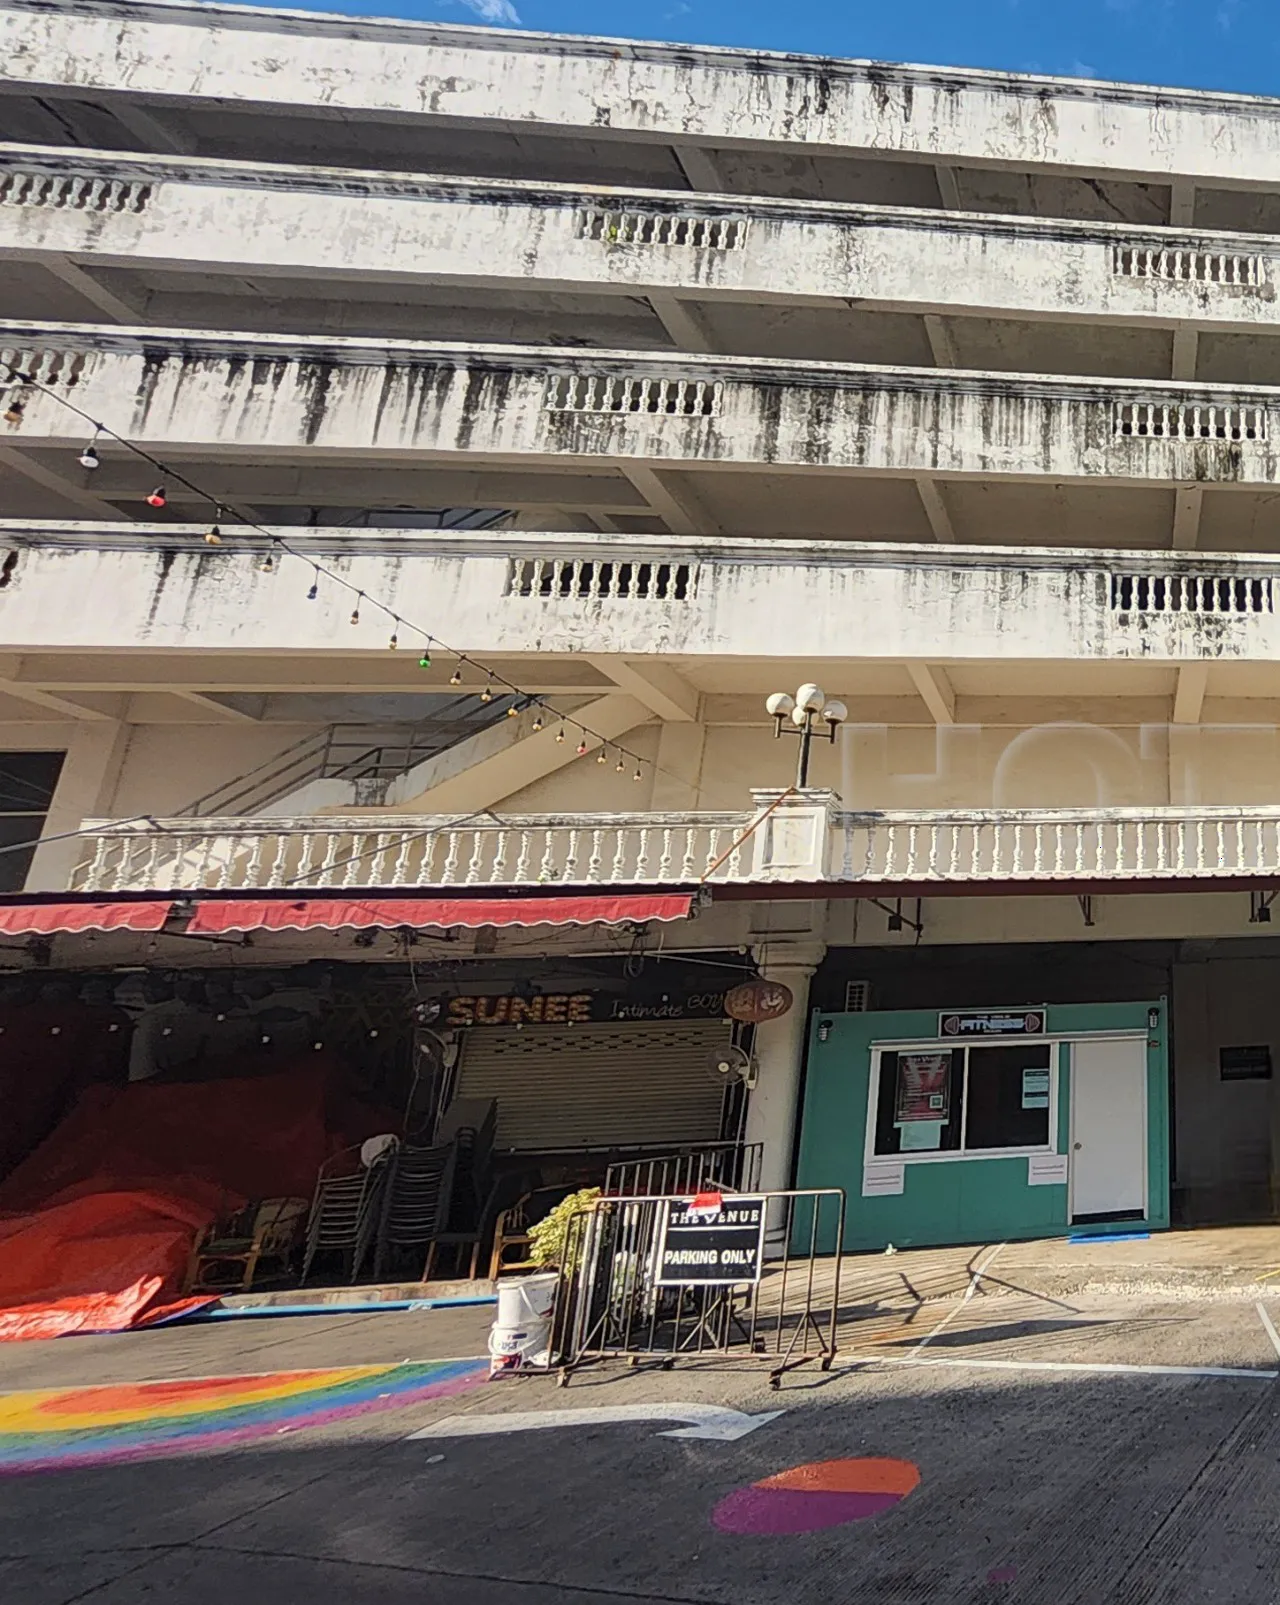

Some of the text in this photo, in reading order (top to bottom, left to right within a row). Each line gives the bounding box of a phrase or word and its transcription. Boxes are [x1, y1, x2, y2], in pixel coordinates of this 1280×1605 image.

[446, 995, 593, 1024] SUNEE
[609, 1000, 683, 1018] Intimate
[664, 1248, 756, 1264] PARKING ONLY
